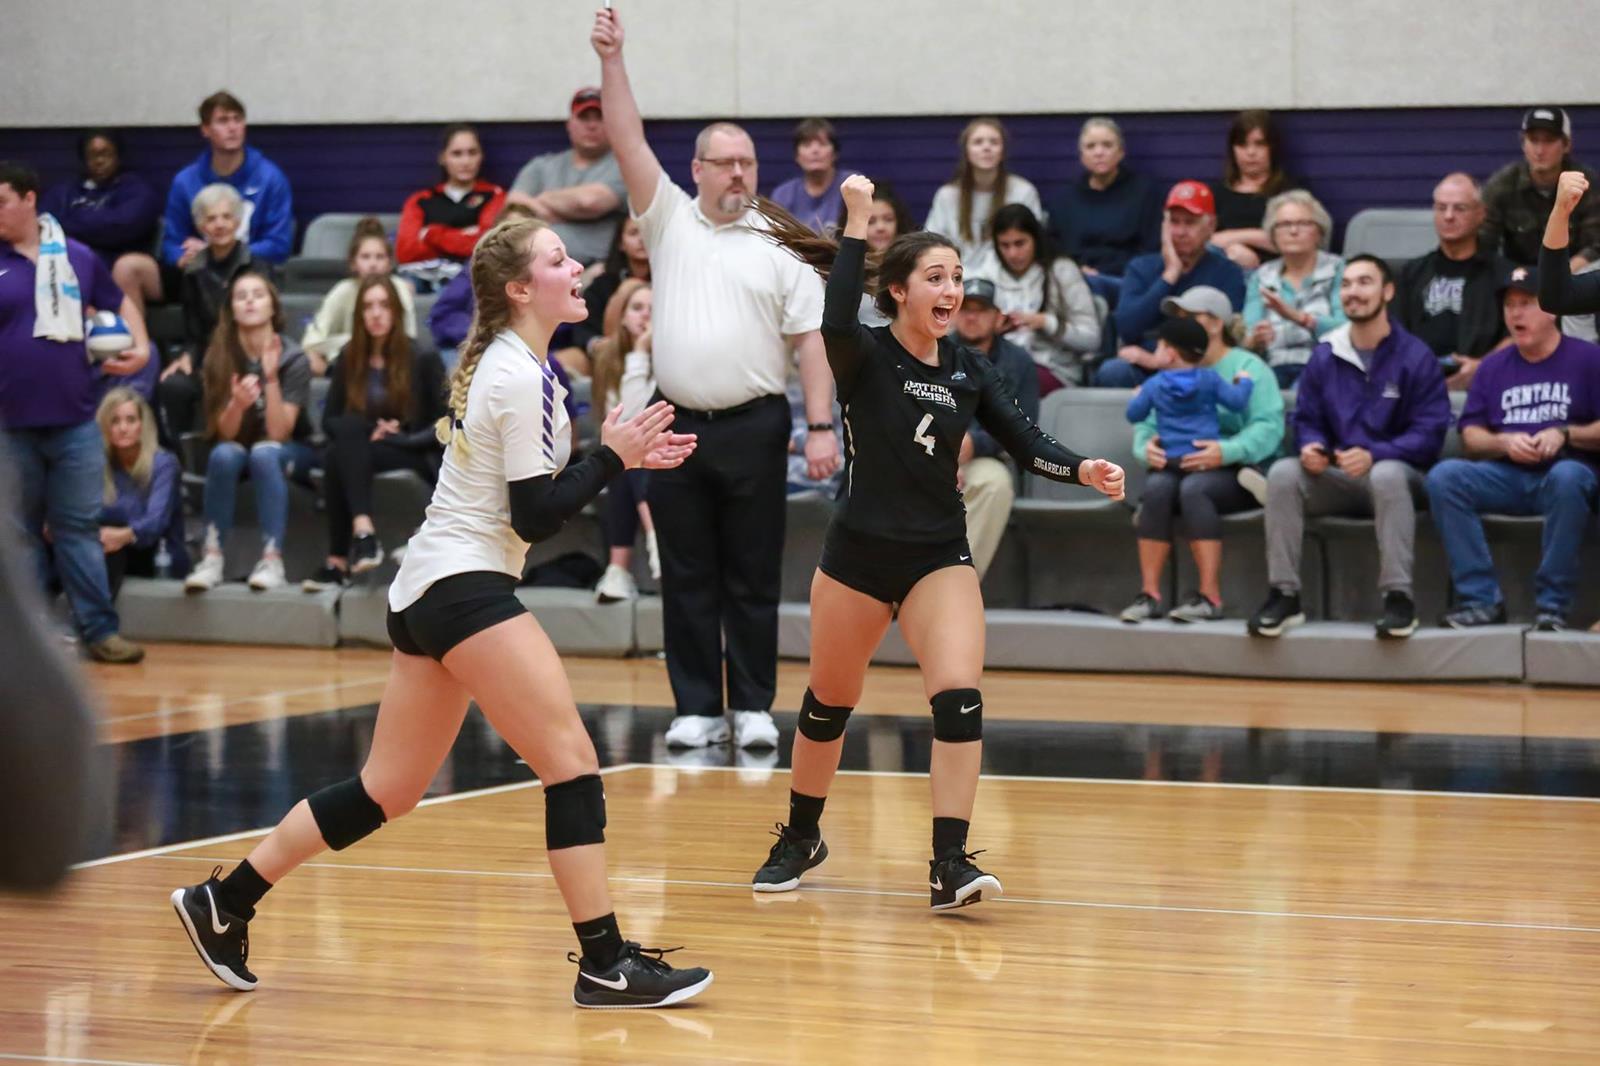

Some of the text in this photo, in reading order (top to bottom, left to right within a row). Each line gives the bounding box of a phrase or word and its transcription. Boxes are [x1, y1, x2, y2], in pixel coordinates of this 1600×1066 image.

[1501, 382, 1572, 410] CENTRAL
[913, 413, 936, 456] 4
[1033, 456, 1071, 477] SUGARBEARS
